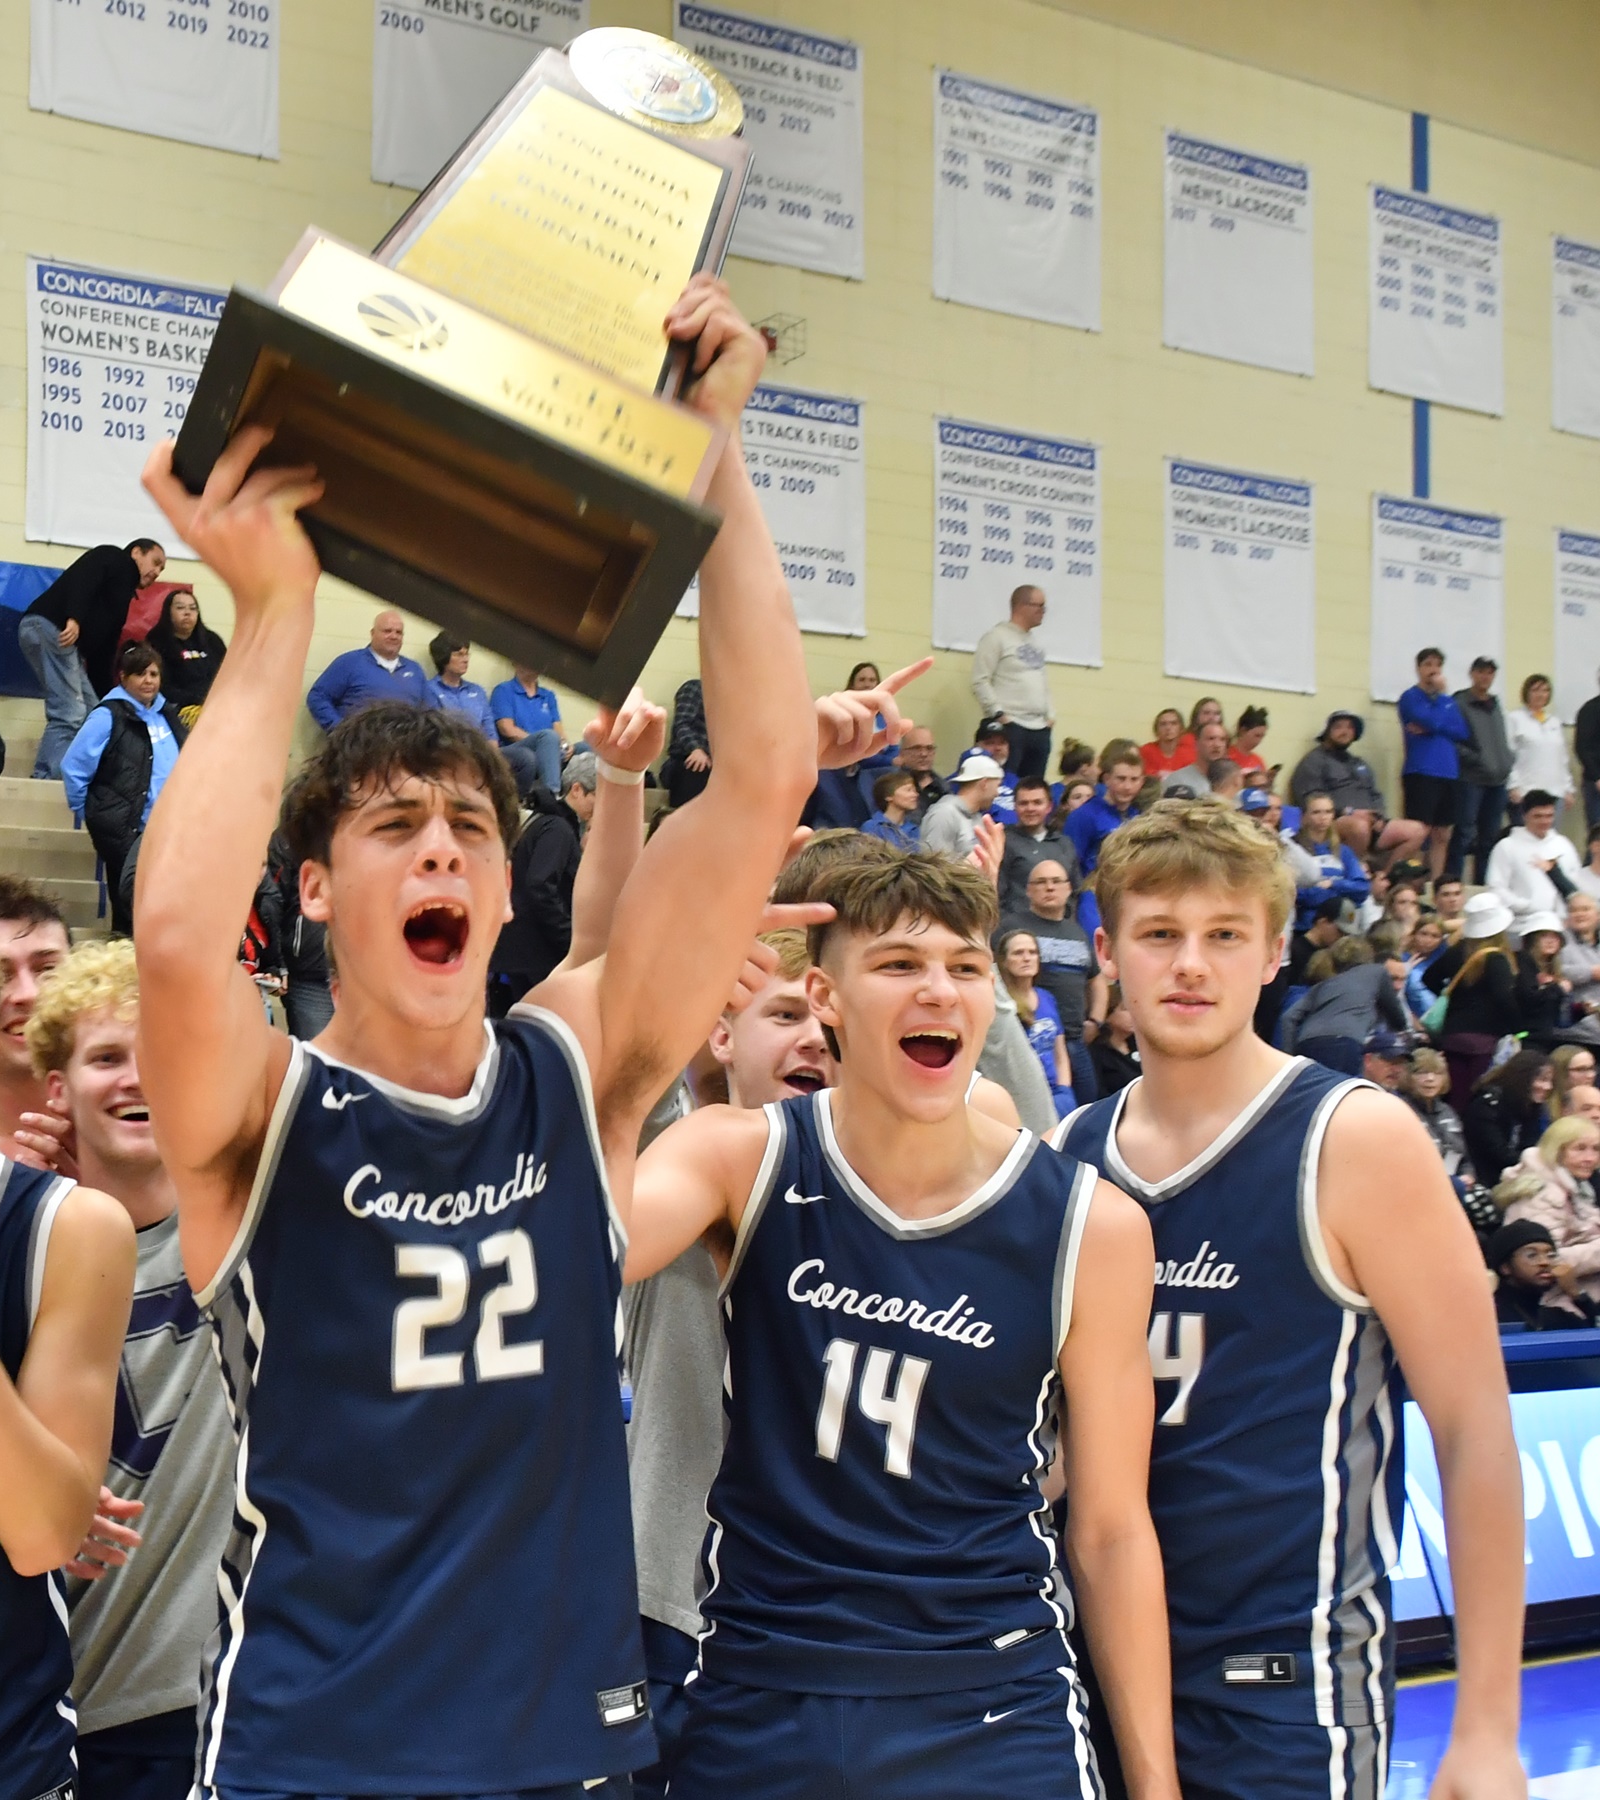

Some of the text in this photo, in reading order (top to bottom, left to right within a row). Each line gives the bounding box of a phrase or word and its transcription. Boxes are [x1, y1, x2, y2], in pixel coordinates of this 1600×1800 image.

[227, 0, 269, 22] 2010
[380, 10, 424, 34] 2000
[490, 7, 541, 33] GOLF
[167, 11, 269, 49] 2019 2022
[741, 54, 789, 77] TRACK
[806, 70, 843, 92] FIELD
[743, 104, 766, 124] 010
[43, 271, 226, 318] CONCORDIA FALC
[40, 299, 160, 332] CONFERENCE
[41, 320, 209, 365] WOMEN'S BASKE
[42, 356, 196, 395] 1986 1992 199
[42, 383, 185, 419] 1995 2007 20
[795, 399, 856, 424] FALCONS
[40, 410, 83, 433] 2010
[103, 420, 145, 441] 2013
[757, 421, 859, 451] TRACK & FIELD
[763, 454, 840, 477] CHAMPIONS
[941, 450, 1021, 475] CONFERENCE
[752, 472, 815, 495] 08 2009
[941, 472, 996, 490] WOMEN'S
[999, 480, 1038, 498] CROSS
[1241, 518, 1310, 543] LACROSSE
[826, 568, 855, 587] 2010
[1154, 1240, 1239, 1289] ordia
[391, 1228, 544, 1393] 22
[787, 1258, 995, 1348] Concordia
[1146, 1310, 1205, 1426] 4
[814, 1337, 932, 1480] 14
[1272, 1661, 1285, 1675] L
[636, 1692, 644, 1708] L
